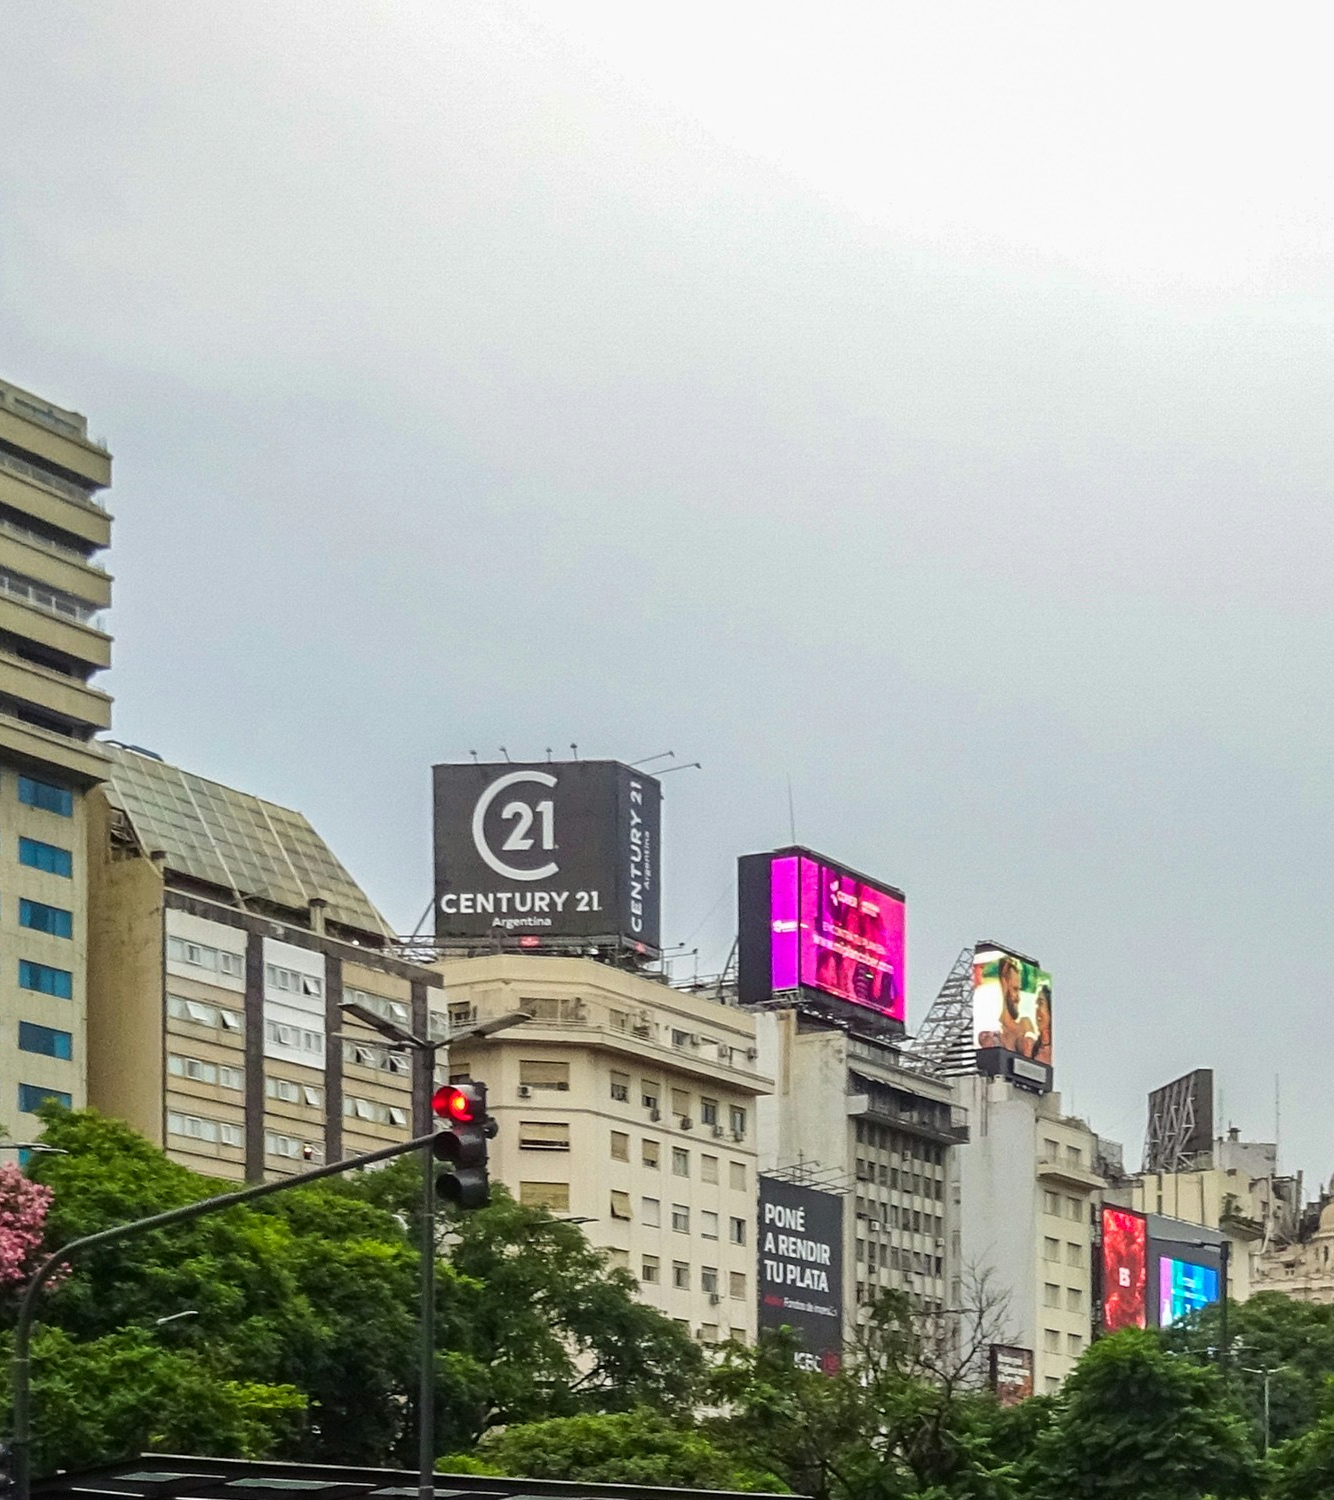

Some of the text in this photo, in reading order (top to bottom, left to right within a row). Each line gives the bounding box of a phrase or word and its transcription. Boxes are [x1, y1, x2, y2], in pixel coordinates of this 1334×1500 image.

[630, 781, 643, 932] CENTURY 21
[441, 891, 600, 914] CENTURY 21
[492, 917, 552, 929] Argentina
[765, 1203, 806, 1232] PONÉ
[764, 1232, 831, 1266] A RENDIR
[764, 1260, 829, 1293] TU PLATA
